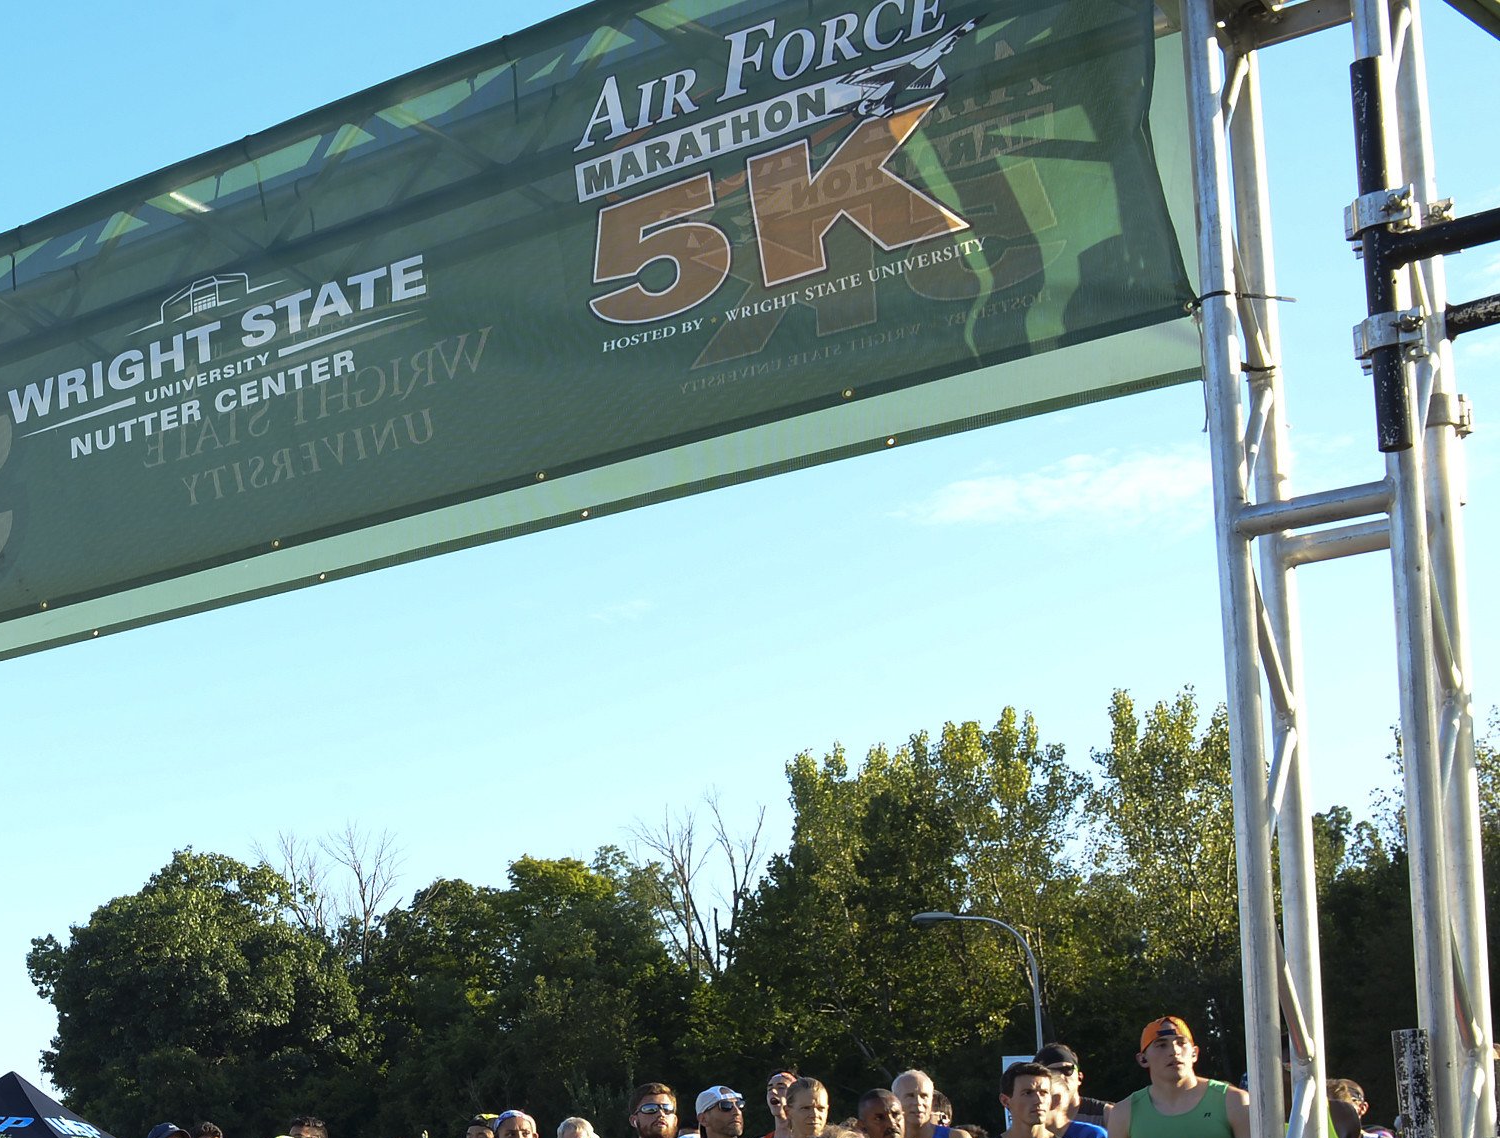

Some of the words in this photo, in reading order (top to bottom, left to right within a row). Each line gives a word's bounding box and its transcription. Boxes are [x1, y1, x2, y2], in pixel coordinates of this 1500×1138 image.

[573, 69, 699, 152] AIR
[717, 0, 946, 103] FORCE
[583, 88, 828, 198] MARATHON
[589, 92, 971, 325] 5K
[7, 320, 228, 425] WRIGHT
[239, 253, 427, 348] STATE
[601, 326, 677, 353] HOSTED
[681, 317, 704, 335] BY
[725, 293, 801, 322] WRIGHT
[805, 274, 862, 303] STATE
[867, 237, 988, 282] UNIVERSITY
[70, 399, 202, 460] NUTTER
[214, 349, 356, 414] CENTER
[144, 351, 271, 404] UNIVERSITY
